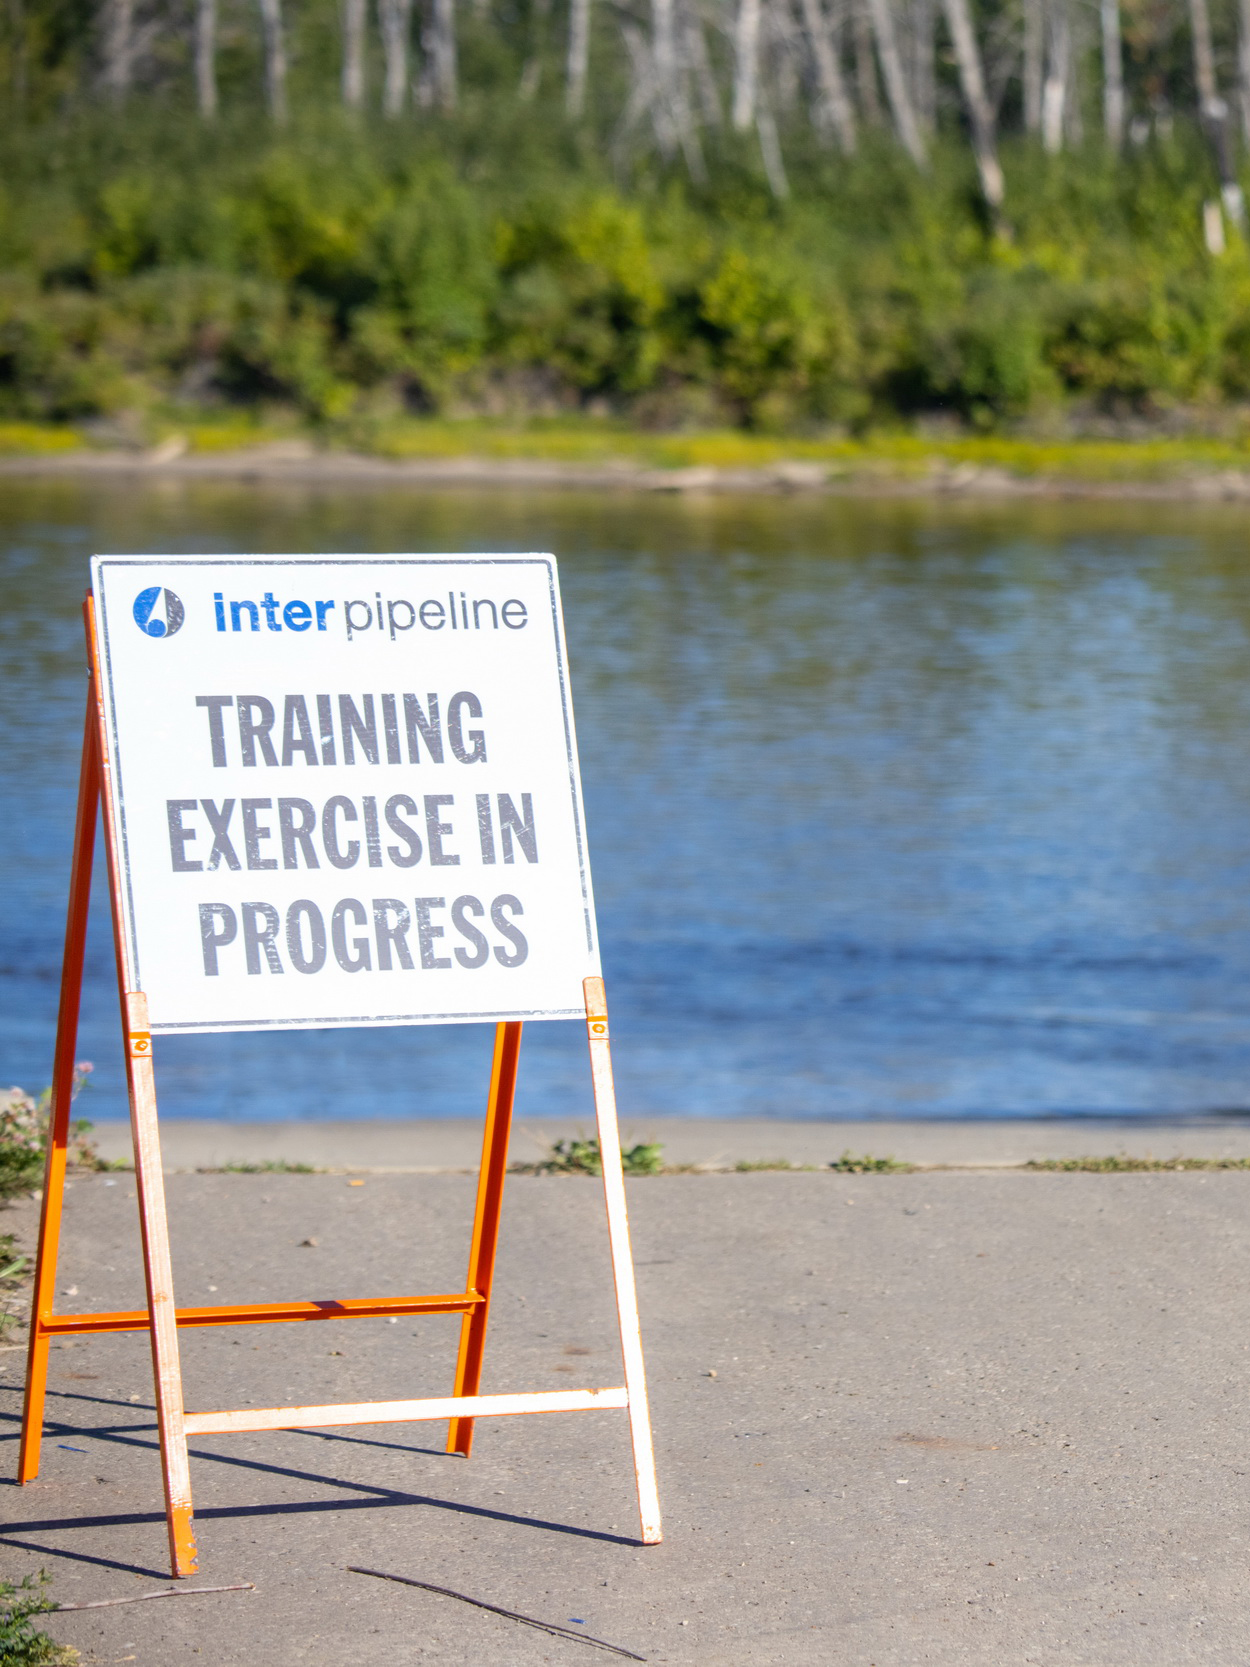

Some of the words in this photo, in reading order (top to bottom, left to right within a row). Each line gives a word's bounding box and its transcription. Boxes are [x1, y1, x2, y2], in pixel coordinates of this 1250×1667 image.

[213, 592, 335, 632] inter
[344, 591, 528, 641] pipeline
[195, 691, 488, 768] TRAINING
[165, 794, 461, 873] EXERCISE
[475, 792, 539, 865] IN
[198, 894, 529, 977] PROGRESS
